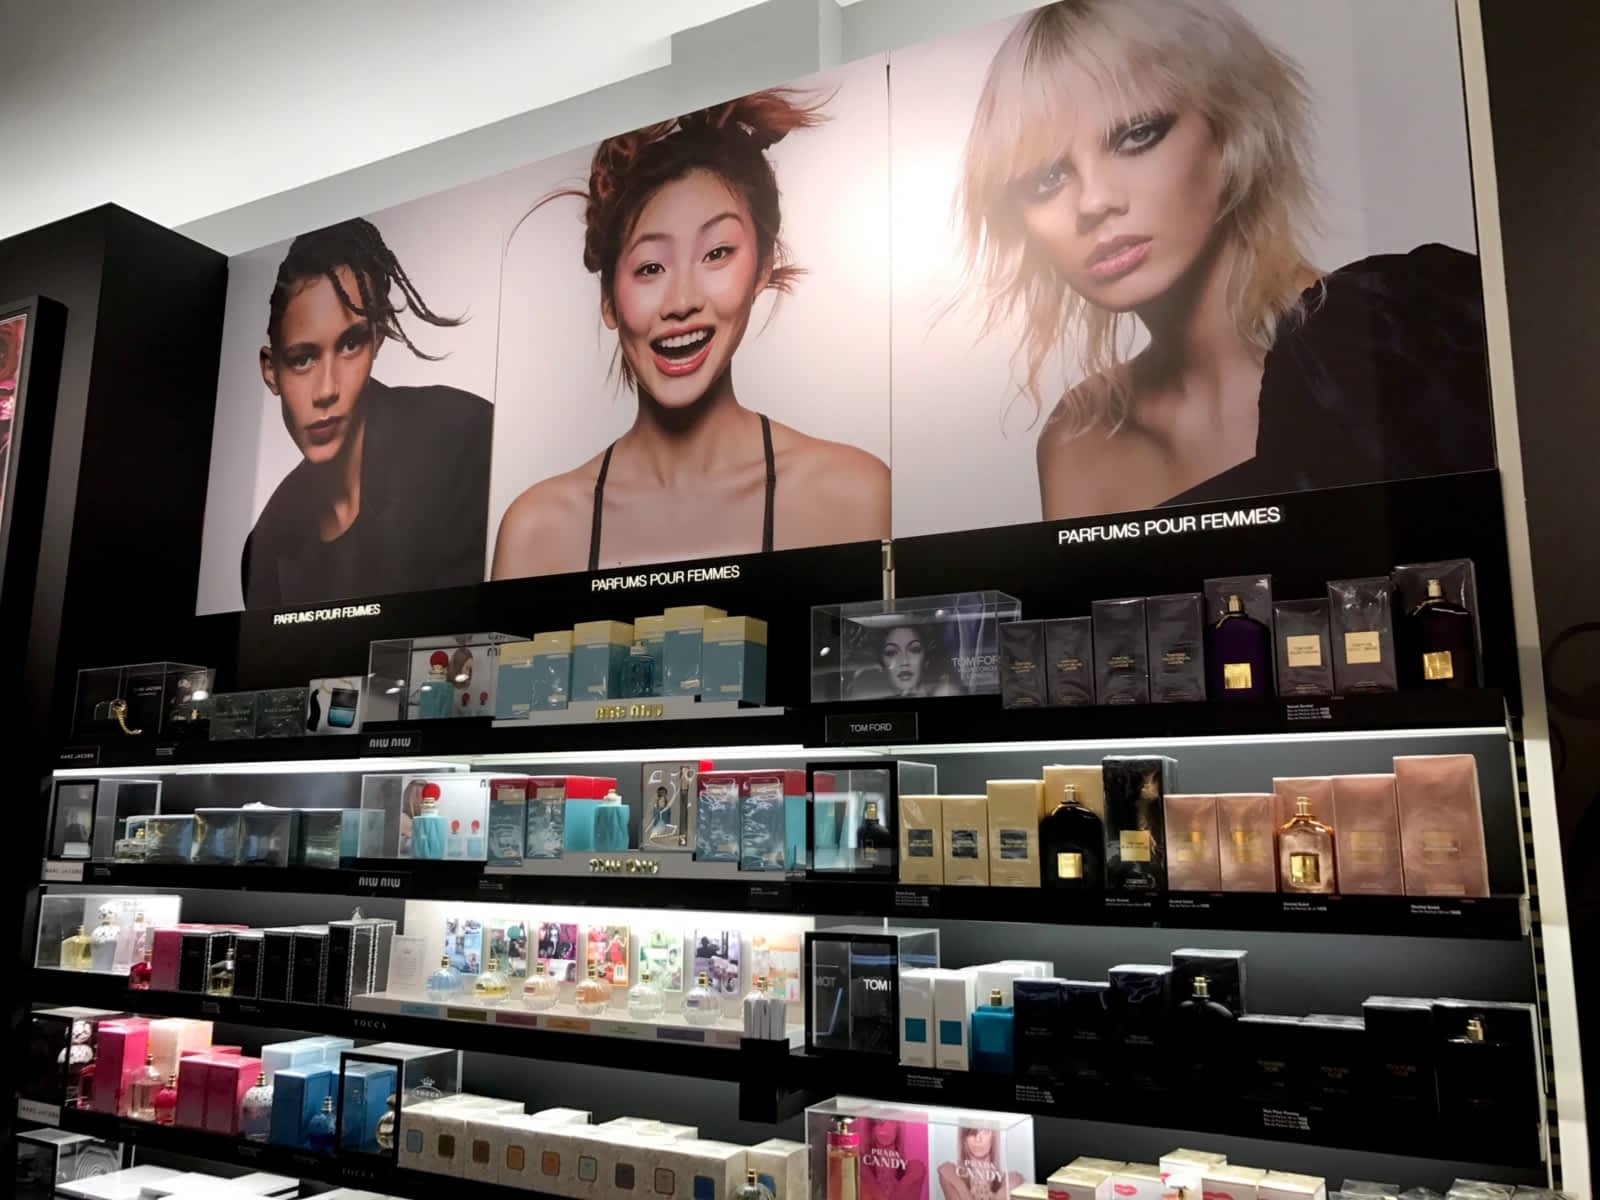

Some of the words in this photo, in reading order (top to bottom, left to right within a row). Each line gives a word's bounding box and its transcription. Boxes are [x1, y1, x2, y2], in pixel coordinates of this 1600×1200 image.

[1057, 522, 1141, 546] PARFUMS
[1143, 515, 1197, 537] POUR
[1200, 506, 1281, 530] FEMMES
[591, 574, 648, 592] PARFUMS
[650, 570, 685, 587] POUR
[686, 564, 740, 583] FEMMES
[273, 610, 314, 625] PARFUMS
[314, 607, 341, 621] POUR
[341, 603, 381, 618] FEMMES
[951, 656, 976, 668] TOM
[976, 655, 1001, 667] FOR
[849, 723, 868, 732] TOM
[868, 723, 892, 732] FORD
[863, 978, 888, 991] TOM
[352, 1018, 387, 1030] TOCCA
[871, 1147, 901, 1159] PRADA
[863, 1154, 908, 1170] CANDY
[955, 1165, 1003, 1183] CANDY
